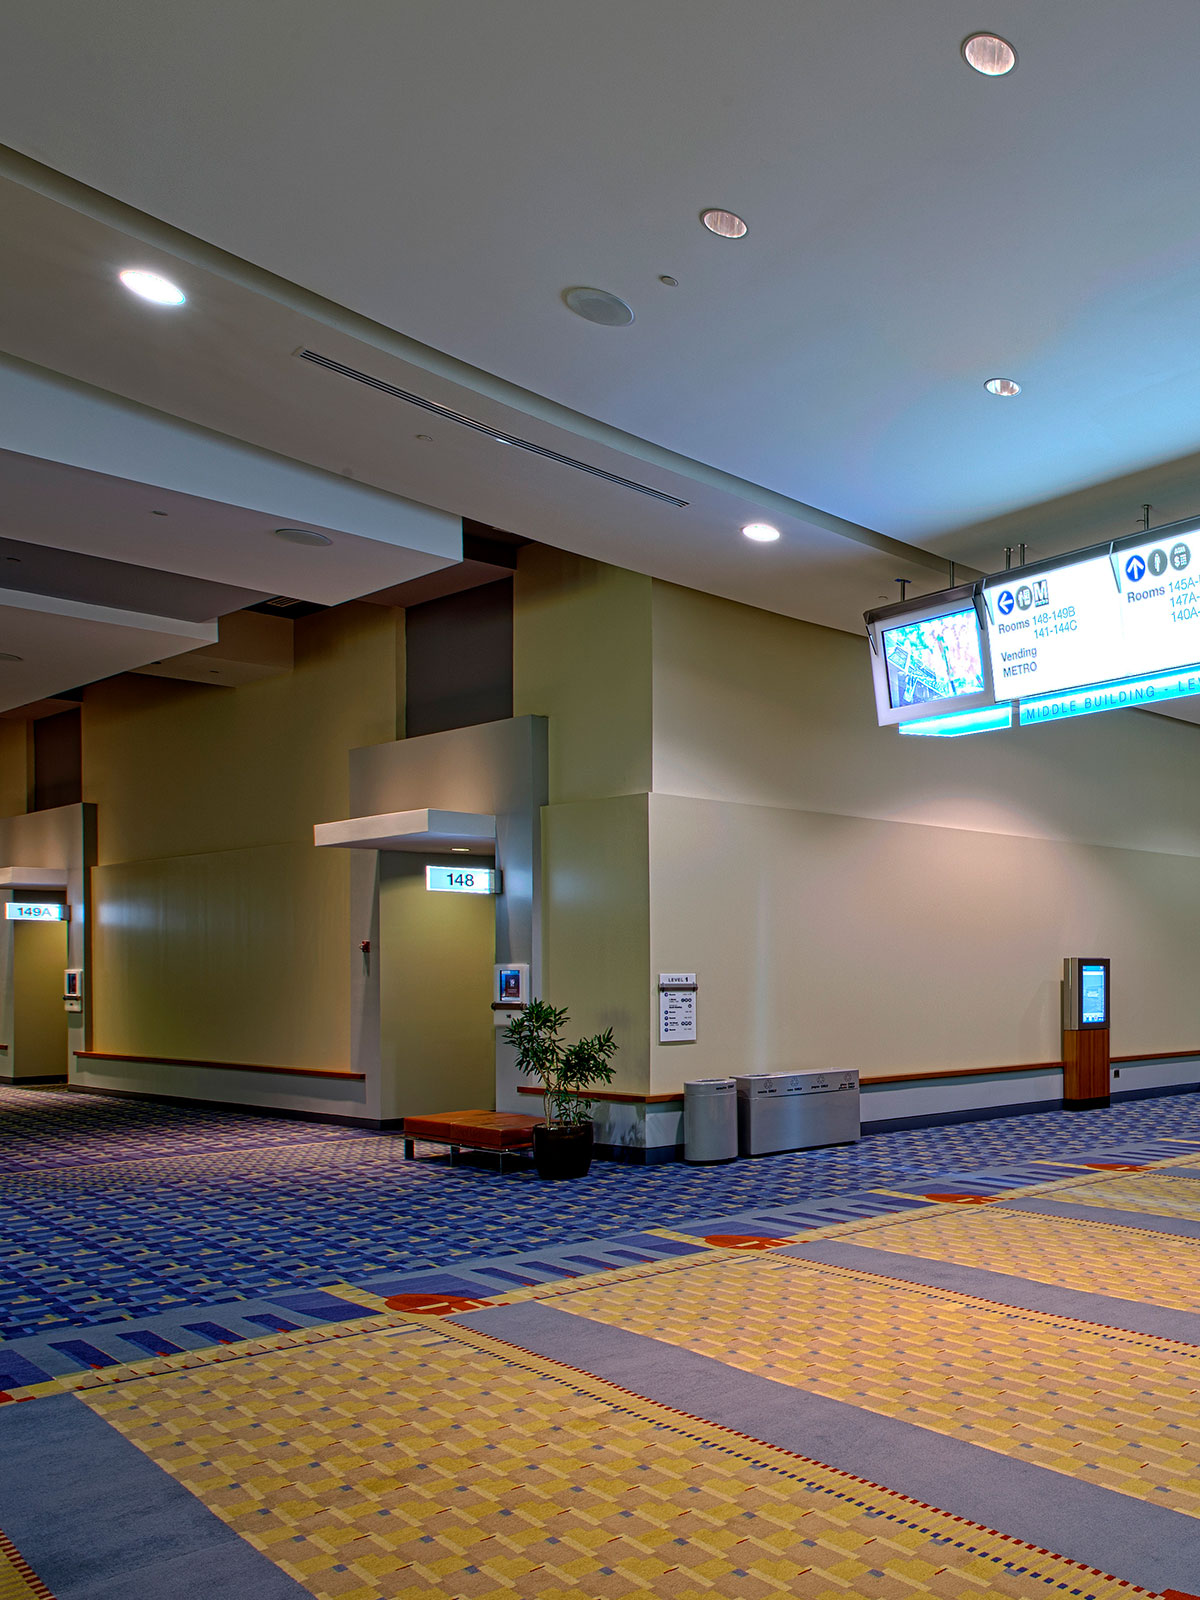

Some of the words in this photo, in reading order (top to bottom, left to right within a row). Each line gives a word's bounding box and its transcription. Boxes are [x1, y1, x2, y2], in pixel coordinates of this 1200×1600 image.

[1127, 586, 1166, 604] Rooms
[998, 619, 1030, 635] Rooms
[1032, 606, 1076, 626] 148-149B
[1033, 619, 1078, 639] 141-144C
[1000, 647, 1038, 662] Vending
[1003, 661, 1038, 678] METRO
[1026, 700, 1077, 720] MIDDLE
[1084, 685, 1156, 710] BUILDING
[446, 872, 475, 887] 148
[17, 907, 52, 917] 149A
